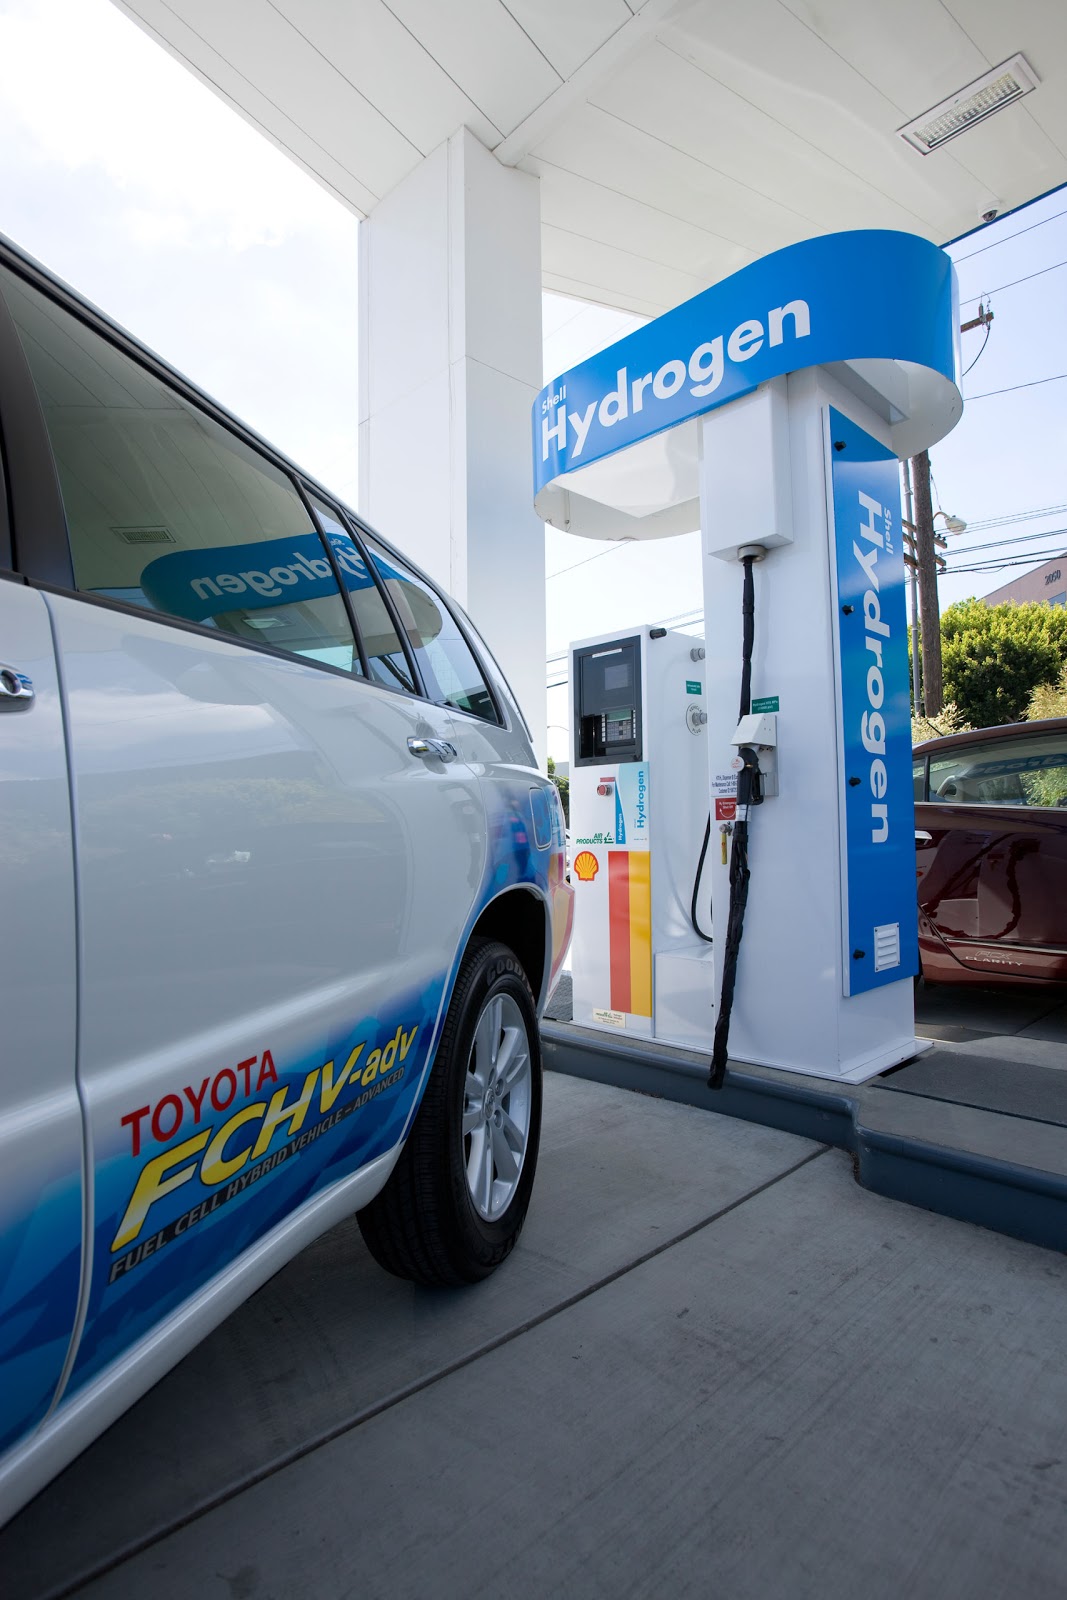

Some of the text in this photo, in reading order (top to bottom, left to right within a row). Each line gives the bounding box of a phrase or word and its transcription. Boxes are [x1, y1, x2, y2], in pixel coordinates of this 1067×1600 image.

[542, 299, 811, 462] Hydrogen
[542, 385, 567, 415] Shell
[883, 506, 893, 555] Shell
[853, 490, 891, 844] Hydrogen
[637, 771, 646, 828] Hydrogen
[966, 956, 1022, 966] CLARITY
[109, 1024, 419, 1254] FCHV-adv
[121, 1050, 278, 1157] TOYOTA
[109, 1231, 167, 1284] FUEL
[174, 1194, 221, 1236] CELL
[226, 1148, 288, 1201] HYBRID
[291, 1109, 344, 1155] VEHICLE
[353, 1066, 405, 1111] ADVANCED
